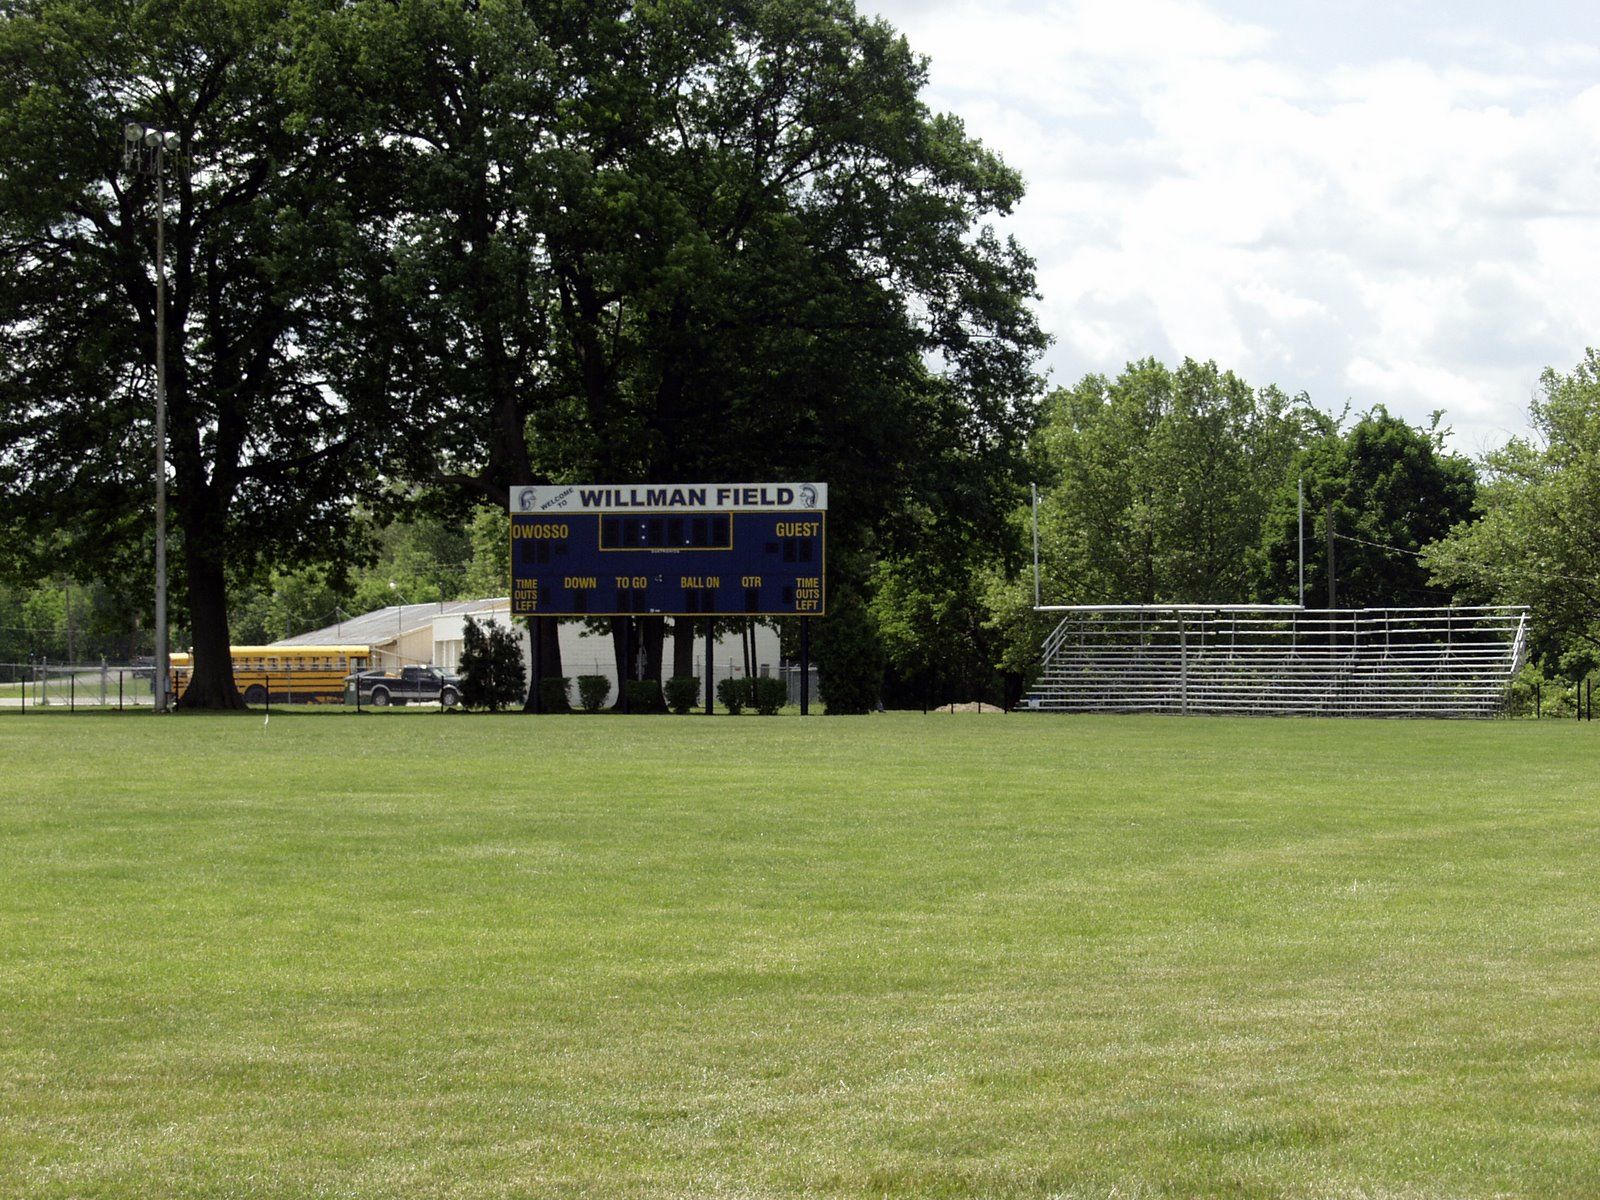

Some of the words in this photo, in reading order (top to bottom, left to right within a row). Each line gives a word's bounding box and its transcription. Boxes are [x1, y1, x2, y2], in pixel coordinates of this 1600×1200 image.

[540, 487, 574, 511] WELCOME
[580, 488, 706, 507] WILLMAN
[717, 488, 794, 506] FIELD
[558, 500, 568, 509] TO
[512, 524, 569, 539] OWOSSO
[776, 522, 819, 537] GUEST
[516, 579, 538, 589] TIME
[564, 577, 596, 589] DOWN
[616, 577, 629, 589] TO
[632, 576, 647, 589] GO
[681, 577, 704, 588] BALL
[706, 577, 720, 588] ON
[742, 577, 762, 588] QTR
[796, 578, 819, 588] TIME
[514, 590, 538, 600] OUTS
[796, 589, 820, 599] OUTS
[516, 601, 537, 611] LEFT
[796, 600, 818, 610] LEFT
